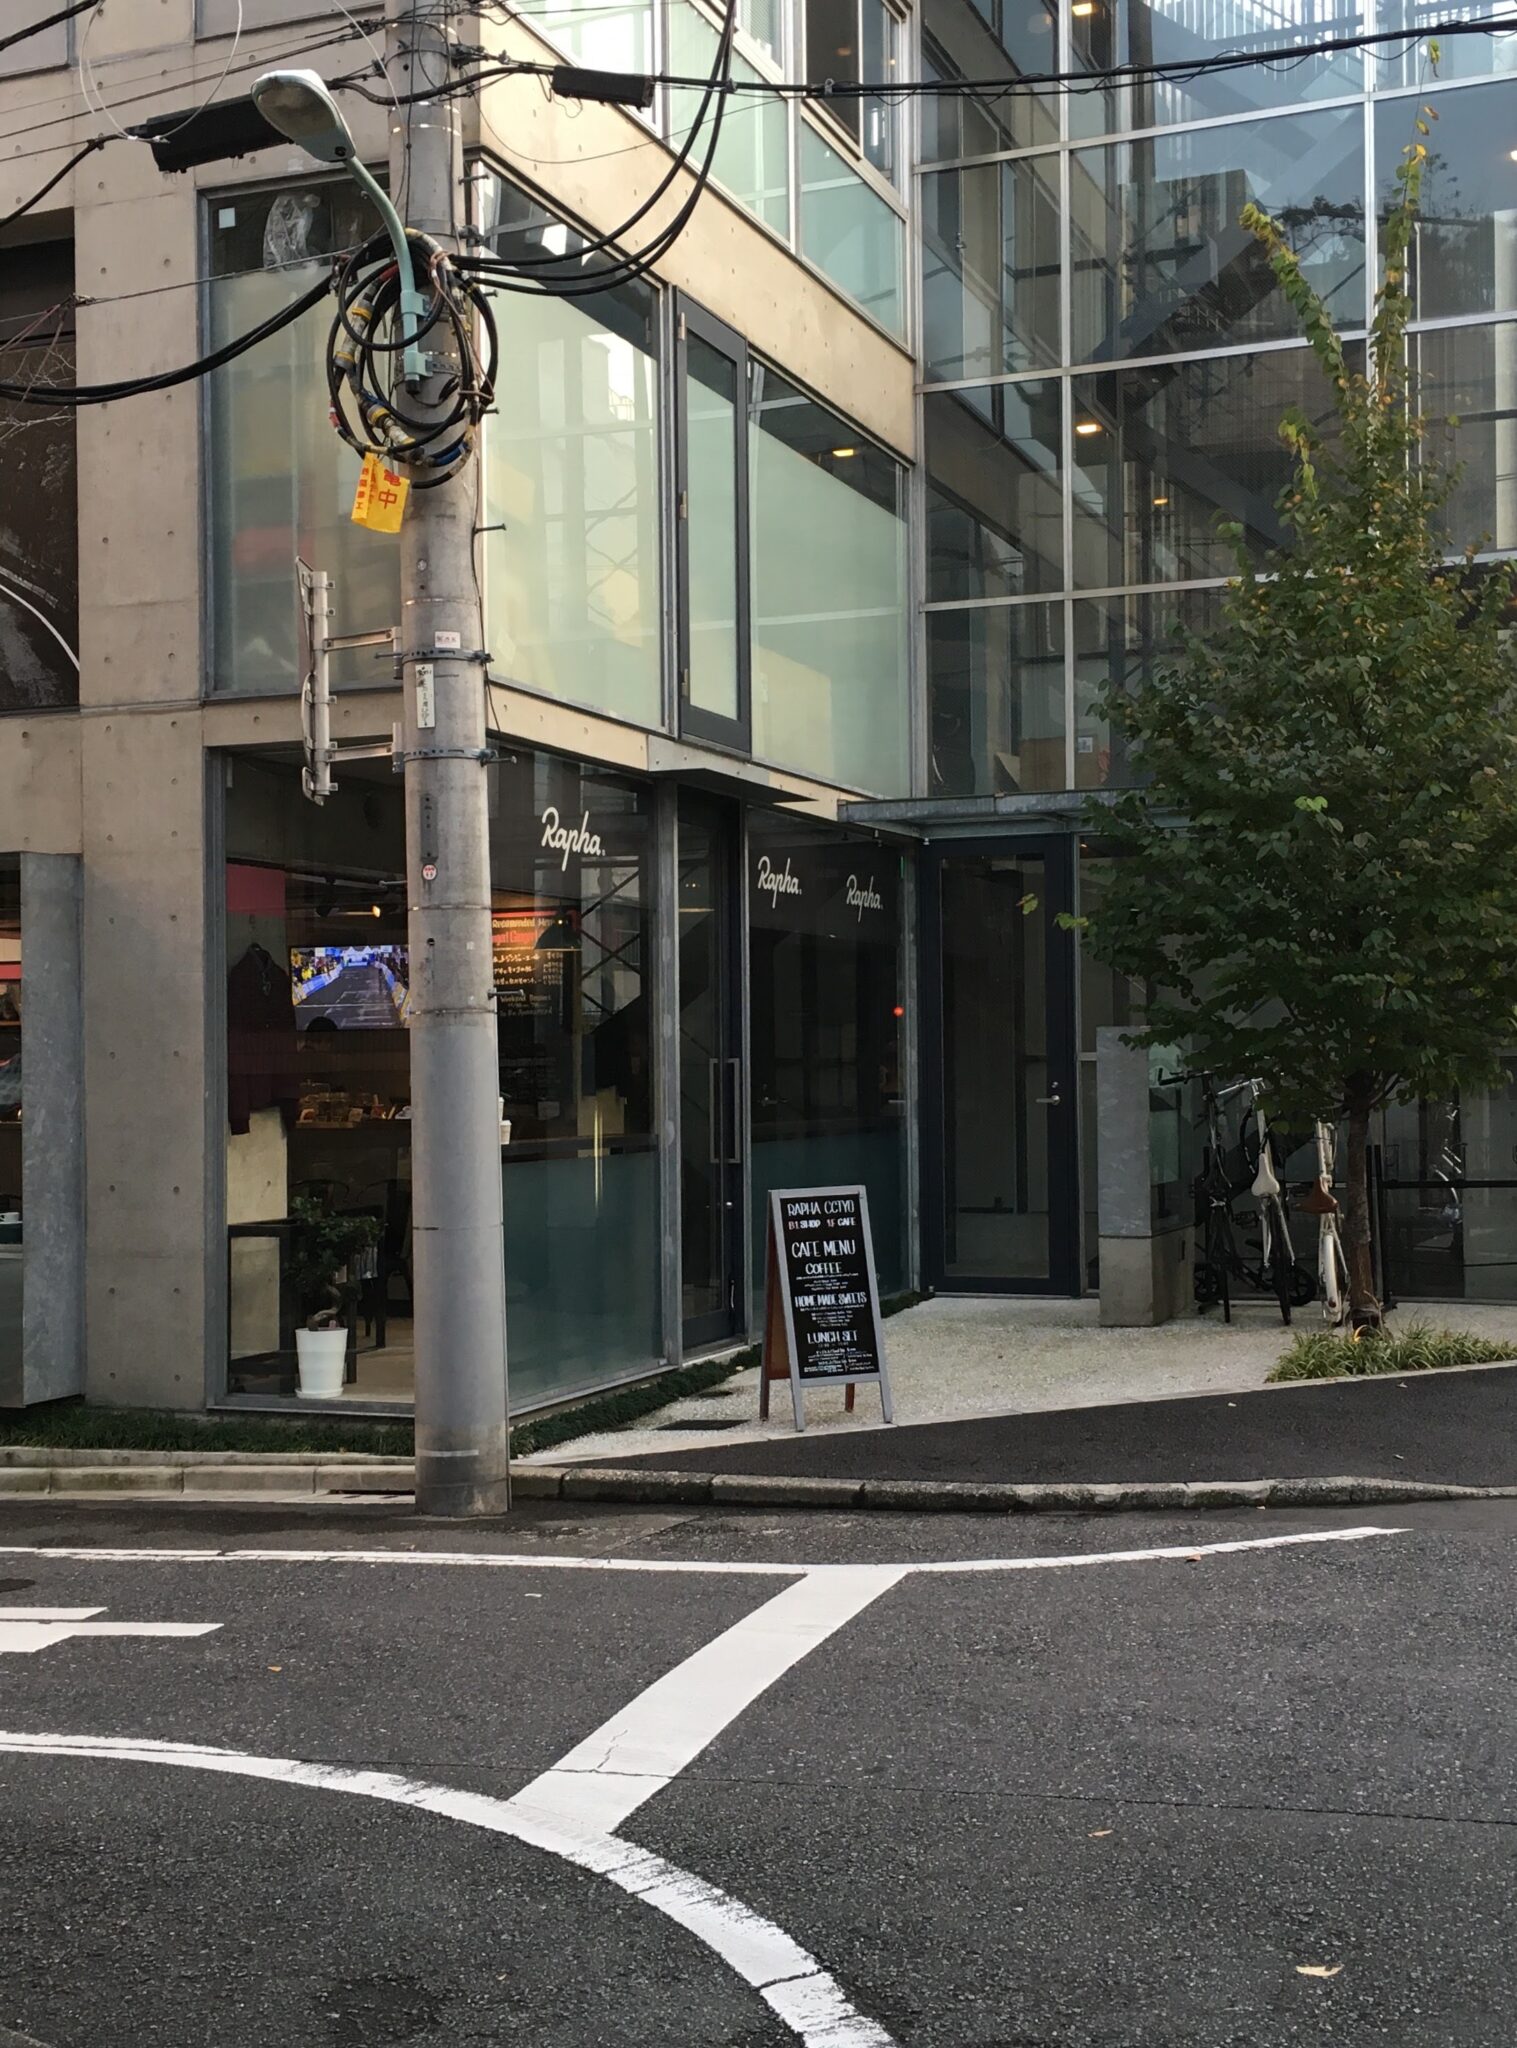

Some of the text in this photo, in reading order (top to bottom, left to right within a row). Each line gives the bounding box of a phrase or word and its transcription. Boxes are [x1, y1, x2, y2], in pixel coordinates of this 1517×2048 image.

[541, 806, 604, 872] Rapha
[758, 855, 801, 909] Rapha
[846, 874, 882, 922] Rapha
[787, 1201, 821, 1217] RAPHA
[800, 1219, 821, 1229] SHOP
[838, 1217, 856, 1226] CAFE
[791, 1239, 856, 1258] CAFE MENU
[805, 1262, 842, 1275] COFFEE
[807, 1329, 857, 1344] LUNCH SET
